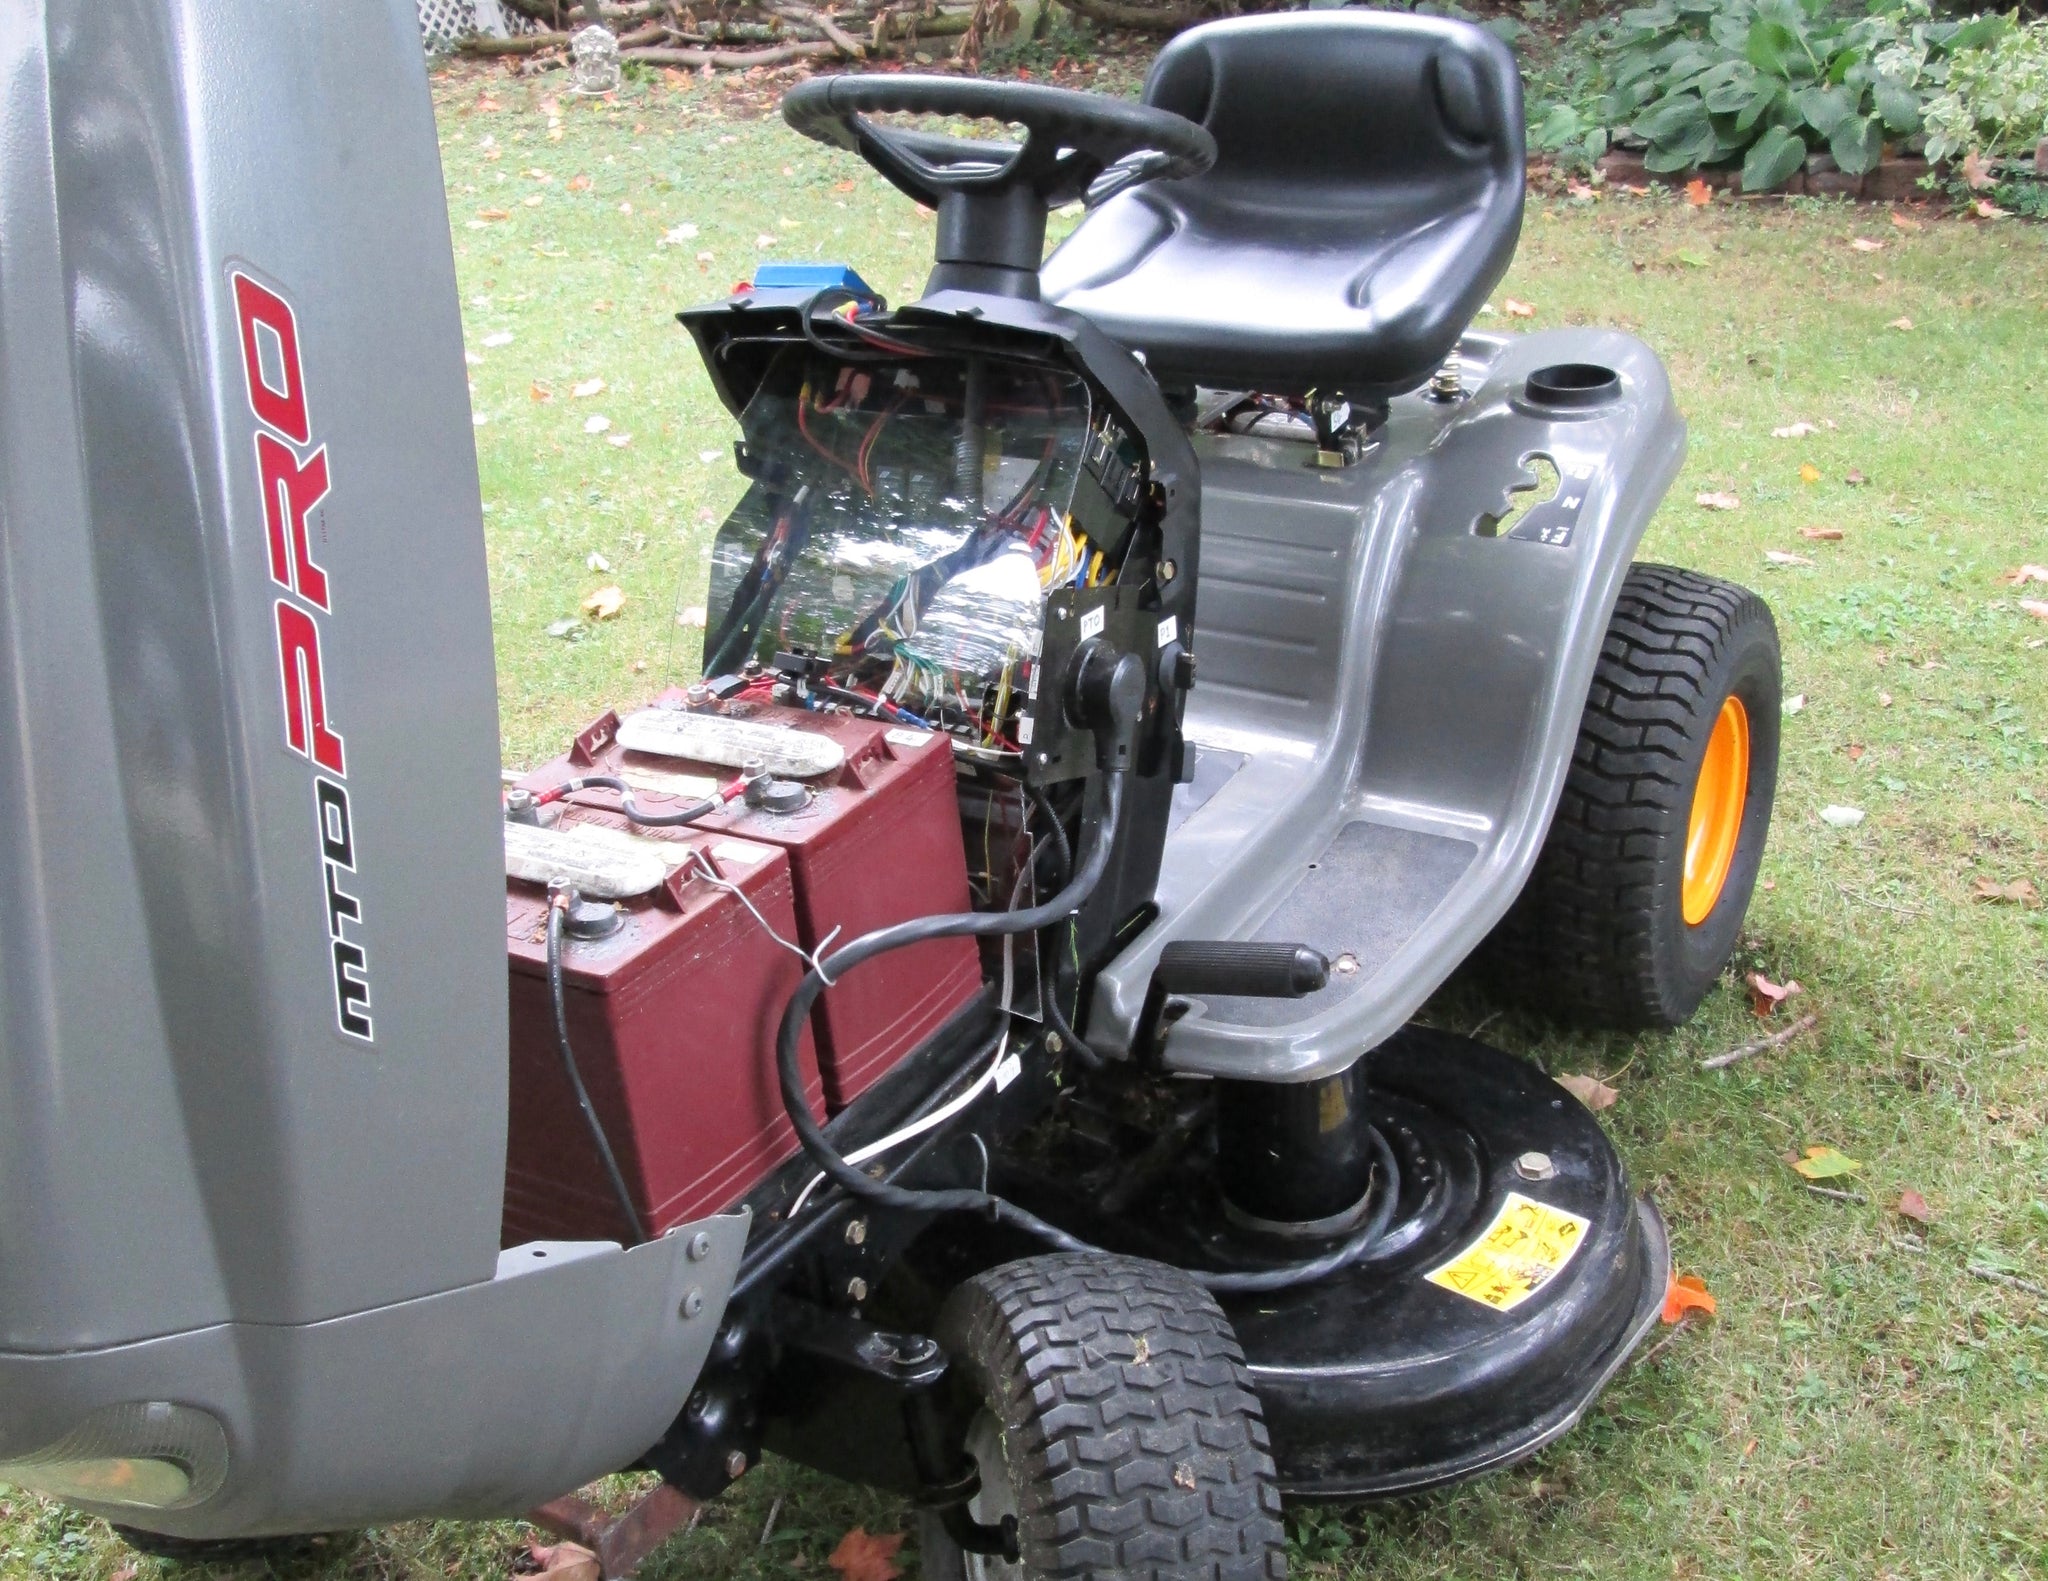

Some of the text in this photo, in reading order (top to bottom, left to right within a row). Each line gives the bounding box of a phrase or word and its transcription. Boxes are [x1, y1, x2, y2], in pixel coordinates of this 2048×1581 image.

[1561, 496, 1580, 509] N
[231, 271, 347, 780] PRO
[1550, 531, 1567, 544] F
[1083, 614, 1101, 633] PTO
[314, 775, 374, 1042] MTD
